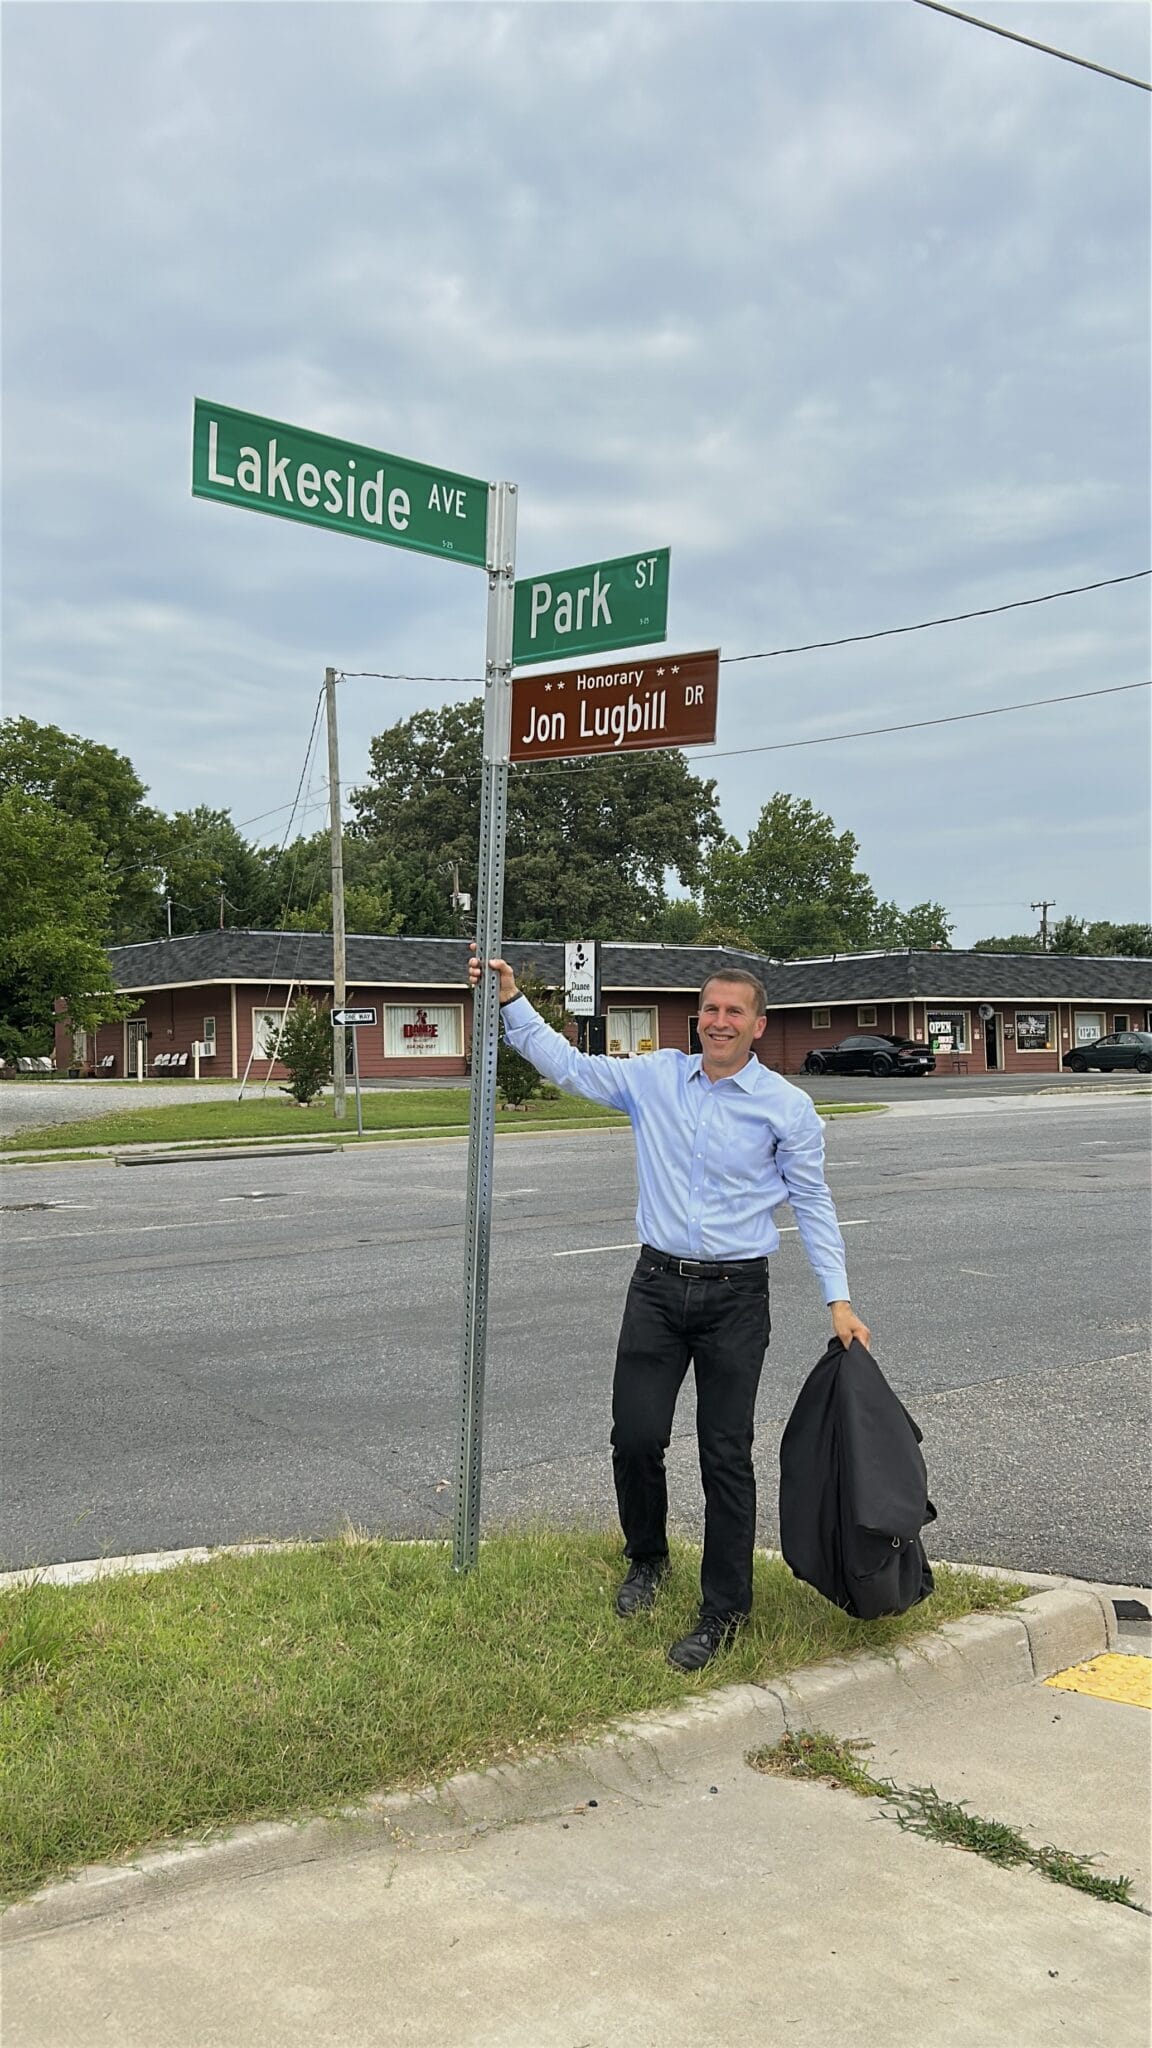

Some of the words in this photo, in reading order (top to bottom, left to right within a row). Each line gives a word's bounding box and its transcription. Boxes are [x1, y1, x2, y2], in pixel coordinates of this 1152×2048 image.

[208, 420, 411, 531] Lakeside
[428, 483, 467, 519] AVE
[530, 570, 613, 639] Park
[634, 557, 658, 589] ST
[576, 669, 644, 691] Honorary
[522, 706, 566, 744] Jon
[579, 689, 667, 747] Lugbill
[684, 684, 705, 707] DR
[571, 981, 590, 991] Dance
[567, 991, 593, 1003] Masters
[344, 1013, 357, 1021] ONE
[403, 1024, 438, 1037] DANCE
[929, 1021, 952, 1034] OPEN
[1079, 1026, 1101, 1040] OPEN
